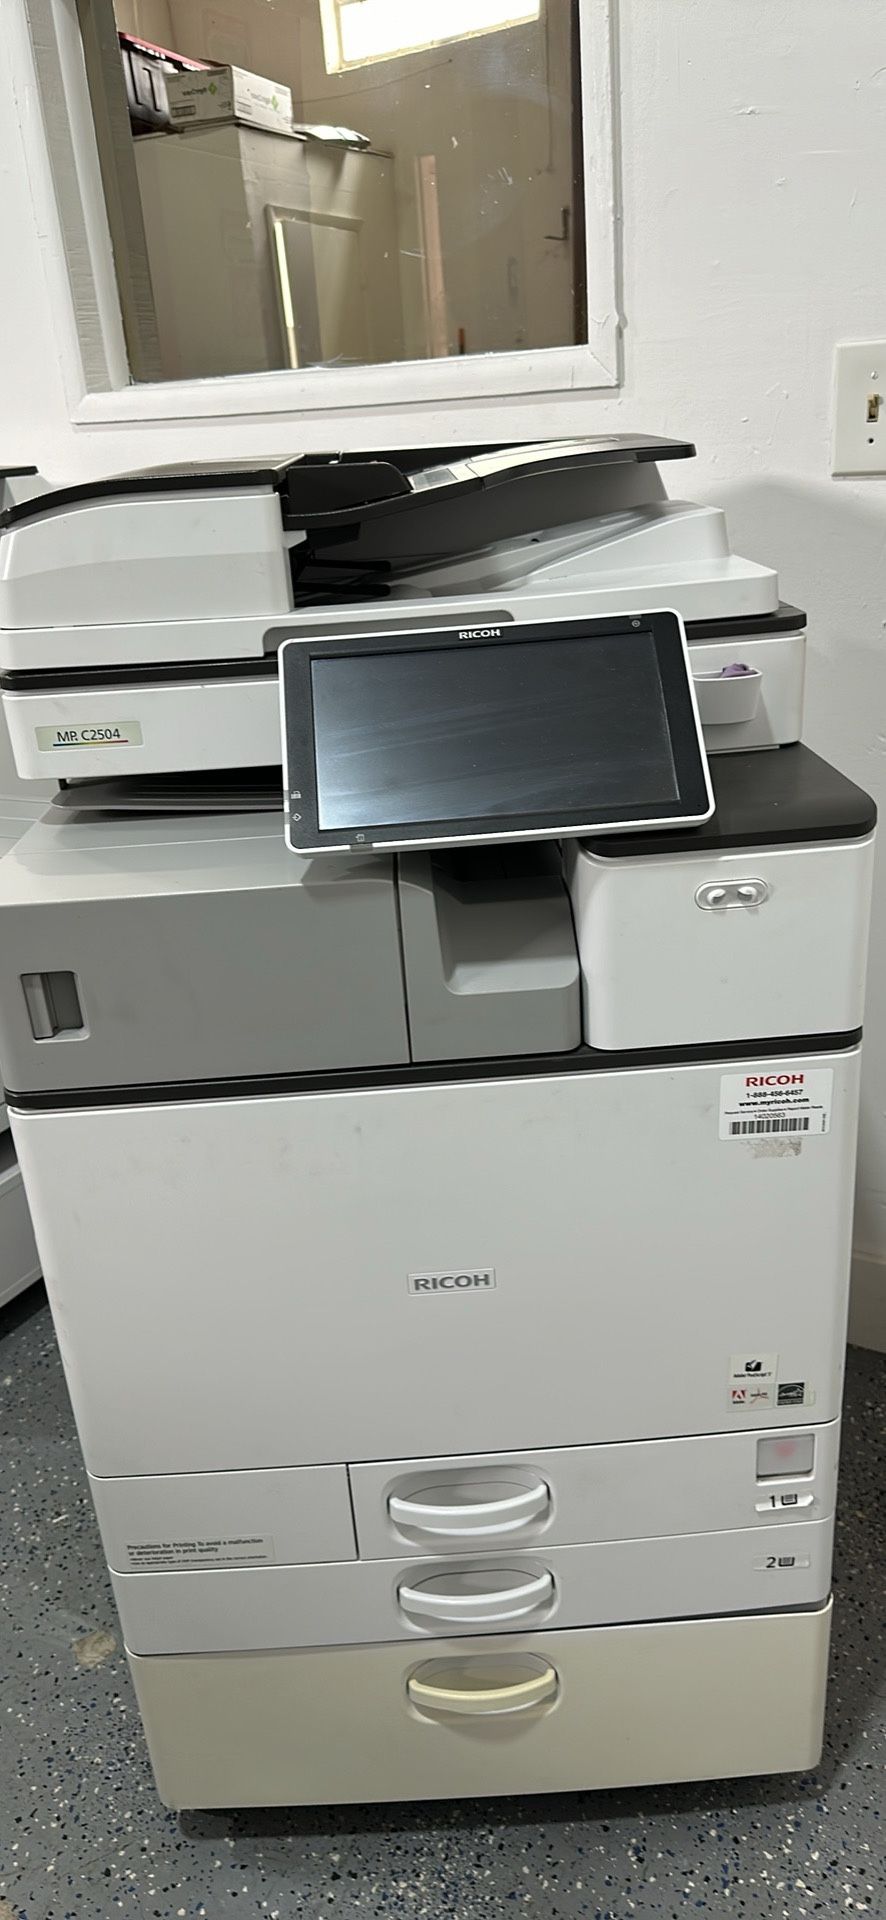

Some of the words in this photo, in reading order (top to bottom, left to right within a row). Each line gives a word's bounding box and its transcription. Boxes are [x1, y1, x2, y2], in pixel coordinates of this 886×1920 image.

[459, 628, 501, 640] RICOH
[81, 728, 121, 741] C2504
[745, 1074, 804, 1087] RICOH
[738, 1098, 810, 1107] www.myricoh.com
[413, 1273, 490, 1291] RICOH
[769, 1495, 776, 1508] 1
[766, 1556, 777, 1568] 2
